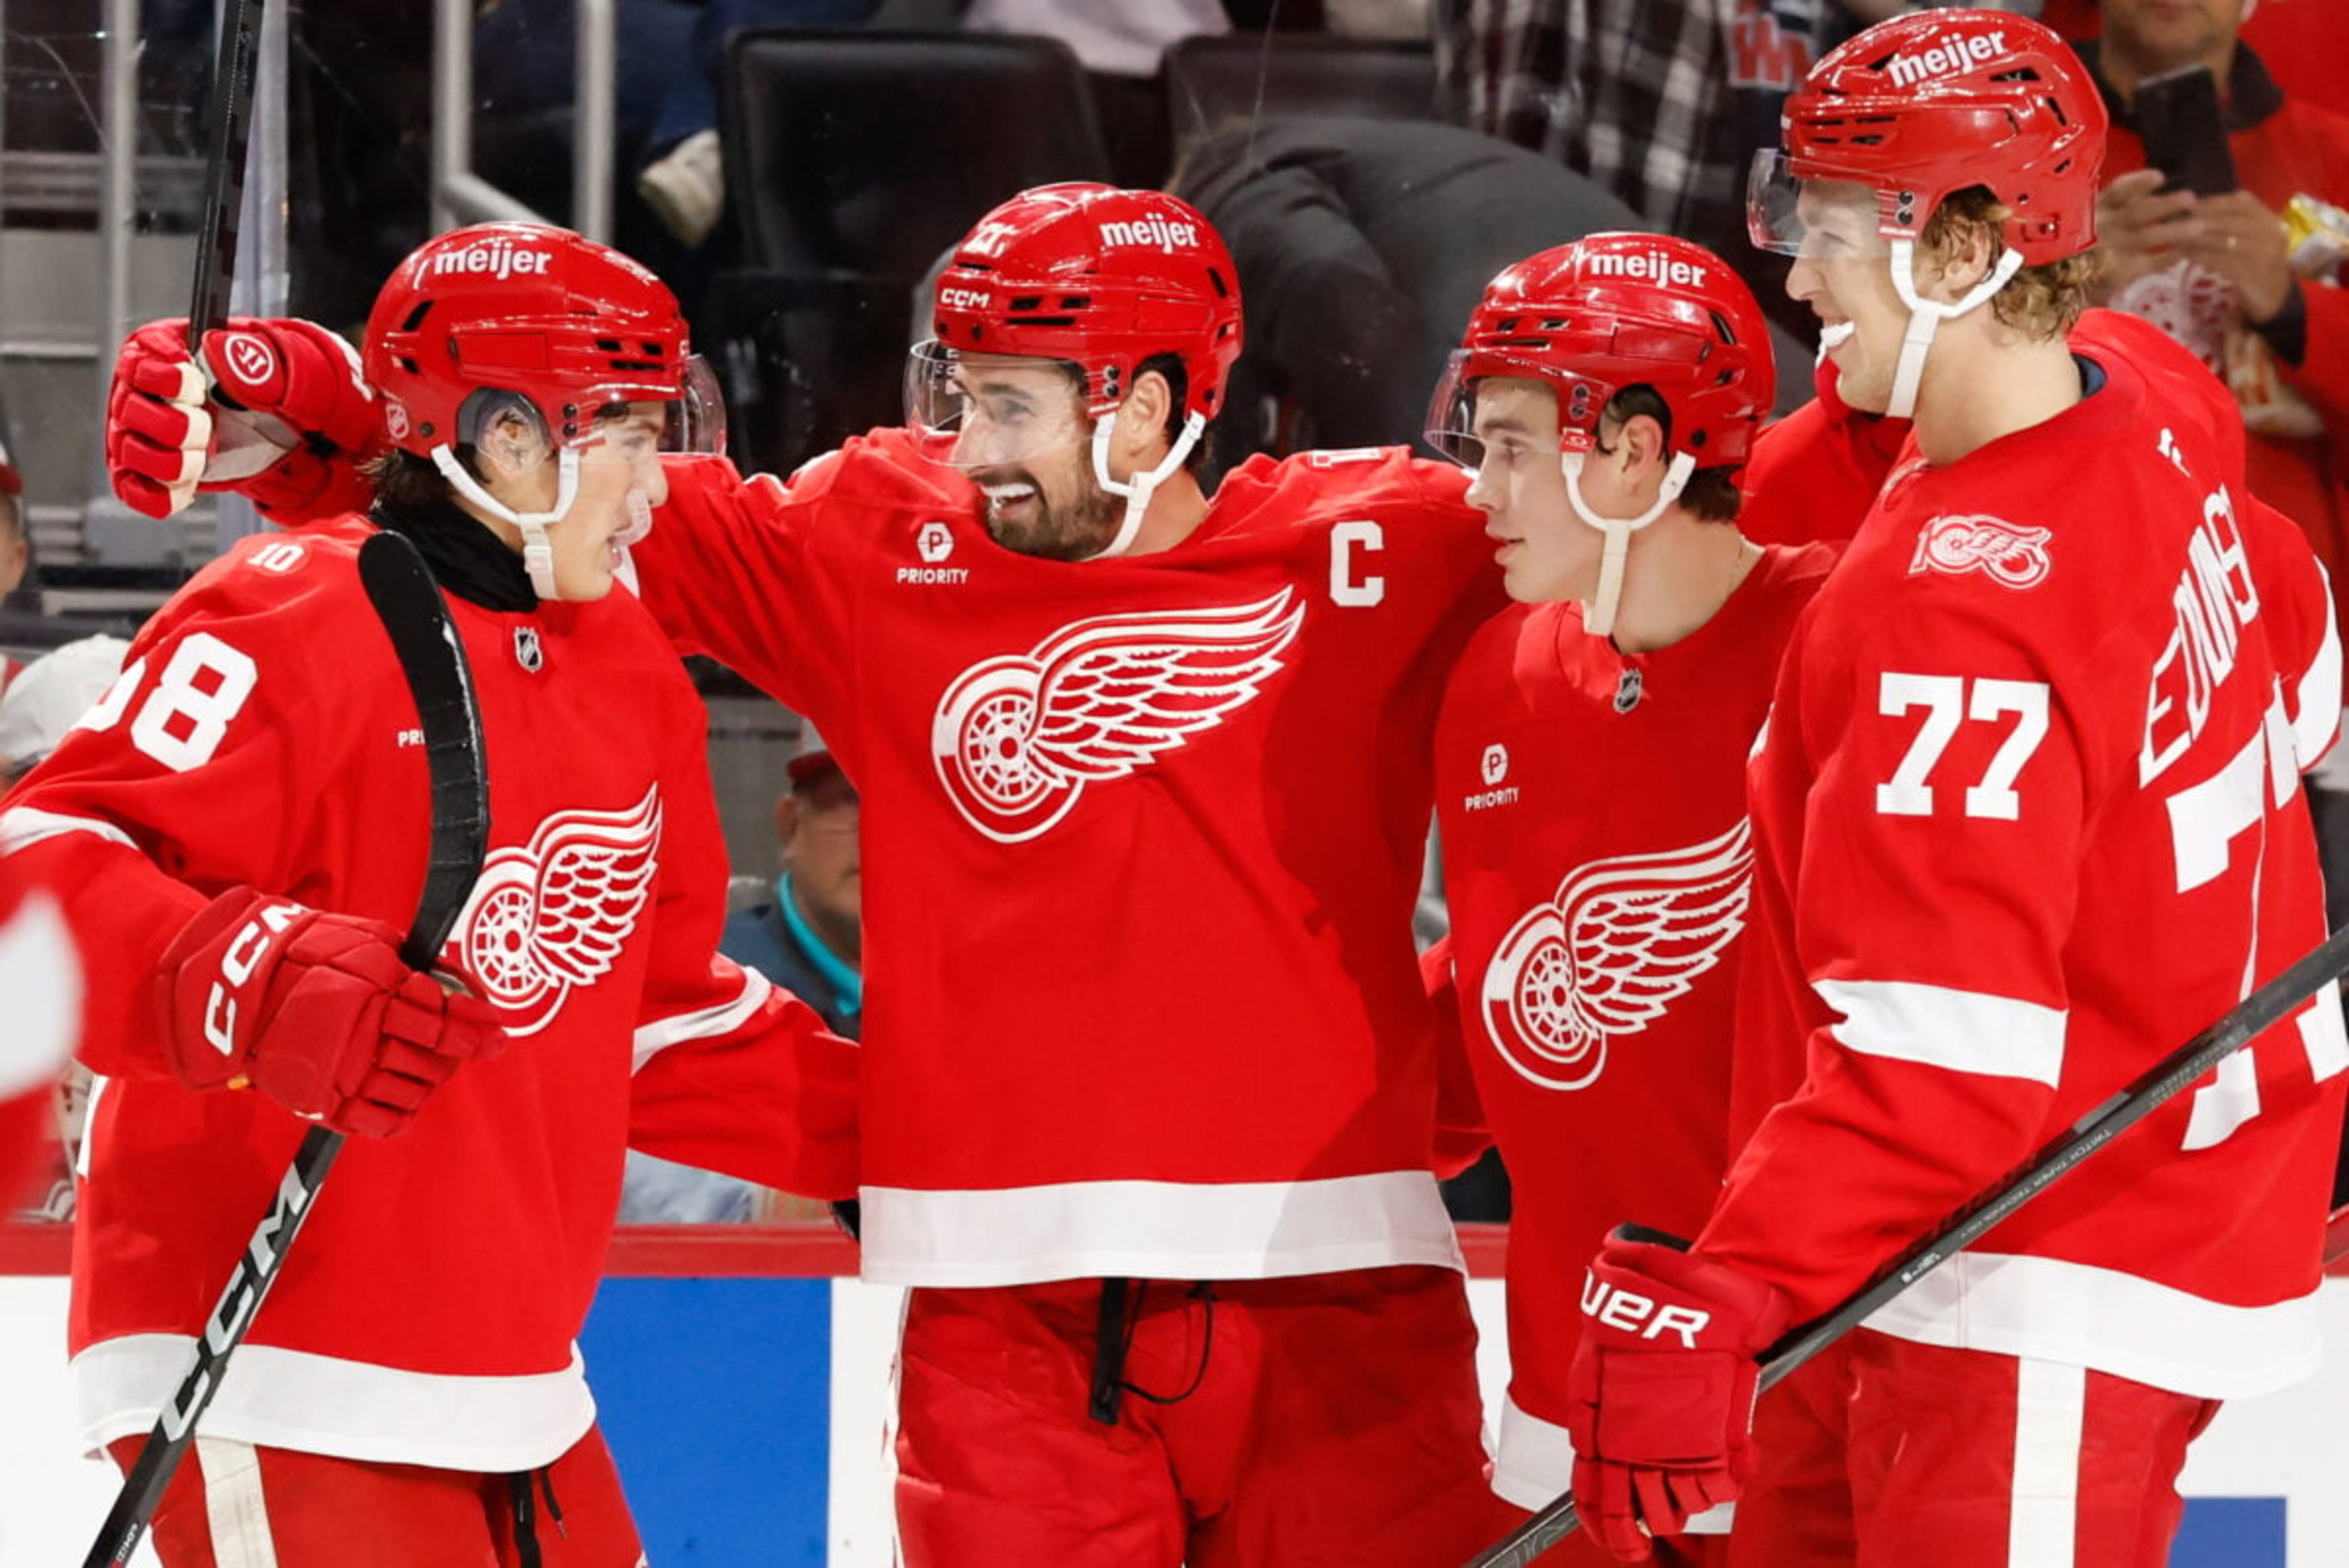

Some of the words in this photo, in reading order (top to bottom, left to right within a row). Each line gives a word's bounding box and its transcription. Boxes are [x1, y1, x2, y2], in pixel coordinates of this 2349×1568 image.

[1889, 30, 2005, 87] meijer
[1099, 211, 1199, 255] meijer
[434, 241, 552, 280] meijer
[1590, 251, 1706, 287] meijer
[941, 287, 989, 308] CCM
[247, 542, 304, 571] 10
[896, 567, 969, 584] PRIORITY
[1330, 520, 1385, 607] C
[1876, 672, 2051, 820] 77
[1465, 787, 1519, 812] PRIORITY
[161, 1160, 308, 1443] CCM
